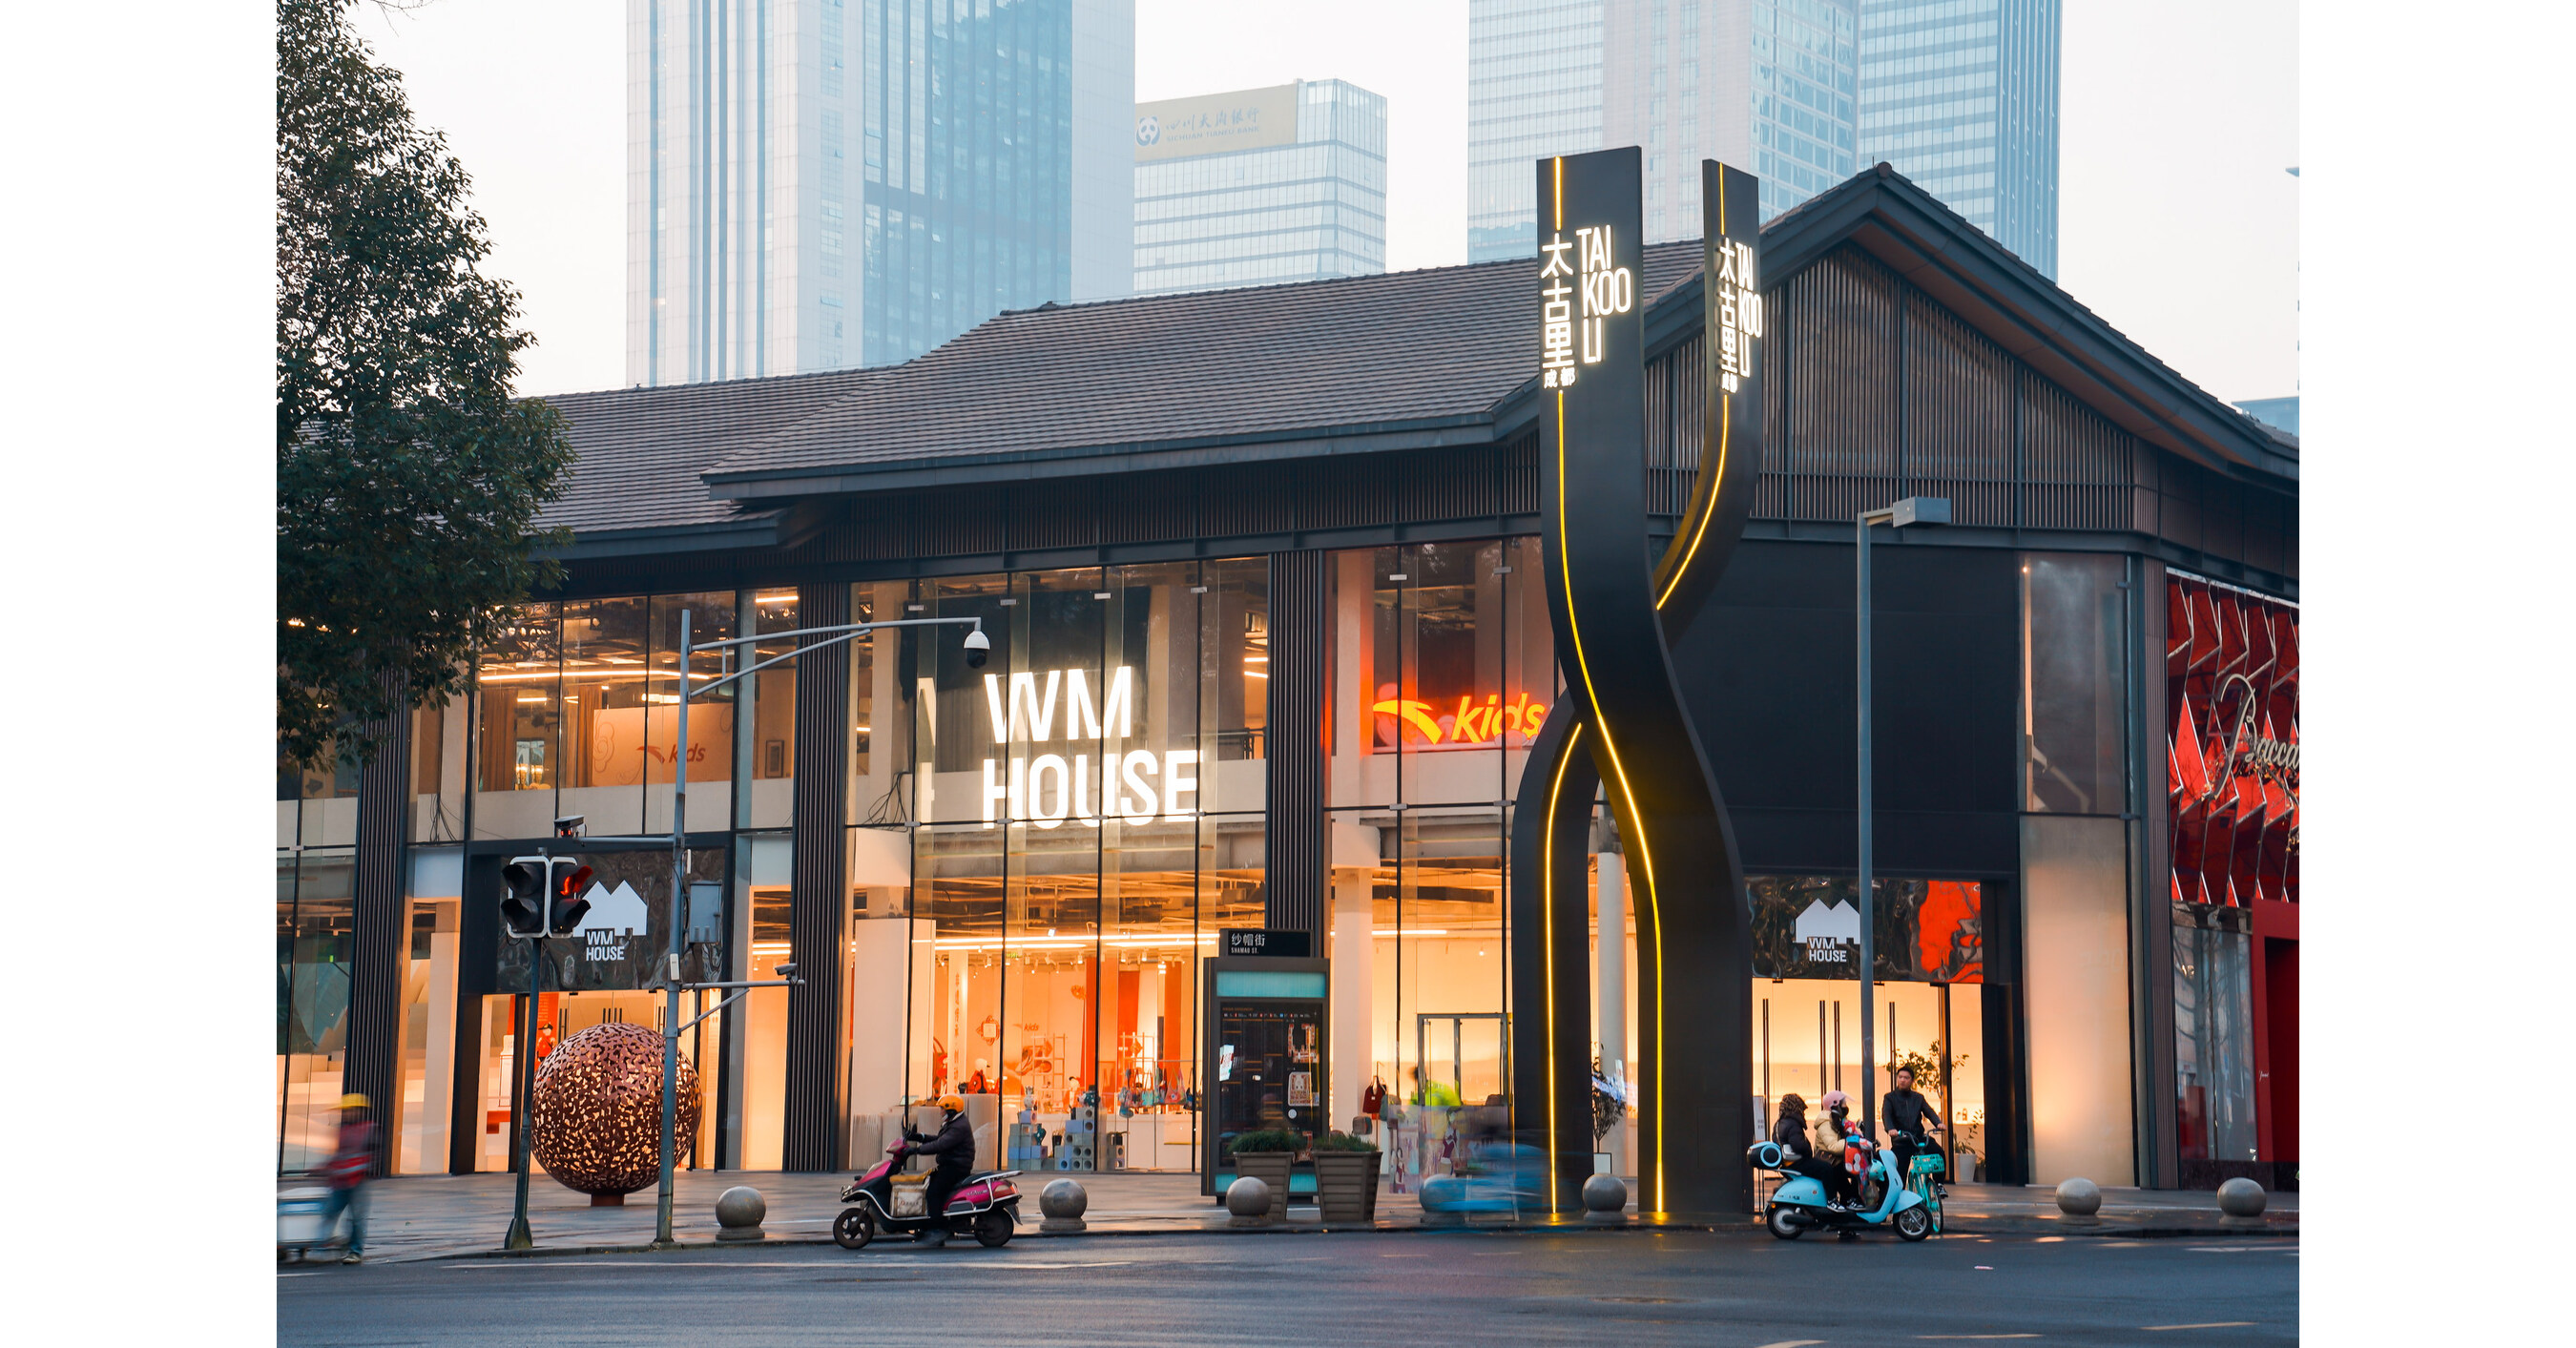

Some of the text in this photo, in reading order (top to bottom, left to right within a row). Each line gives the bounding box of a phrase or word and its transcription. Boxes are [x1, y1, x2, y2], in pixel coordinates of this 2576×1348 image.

[1167, 125, 1259, 142] SICHUAN TIANFU BANK
[1575, 224, 1611, 274] TAI
[1735, 240, 1754, 291] TAI
[1540, 232, 1575, 369] 太古里
[1581, 266, 1631, 318] KOO
[1718, 237, 1738, 374] 太古里
[1737, 288, 1763, 339] KOO
[1583, 317, 1603, 364] LI
[1738, 331, 1751, 378] LI
[1543, 367, 1576, 389] 成都
[984, 665, 1132, 744] WM
[1450, 692, 1547, 744] kids
[669, 742, 706, 764] kds
[983, 749, 1204, 830] HOUSE
[586, 945, 626, 962] HOUSE
[587, 930, 614, 945] WM
[1231, 933, 1266, 946] 纱帽街
[1808, 937, 1836, 950] WM
[1808, 949, 1847, 963] HOUSE
[1024, 1023, 1039, 1031] kids
